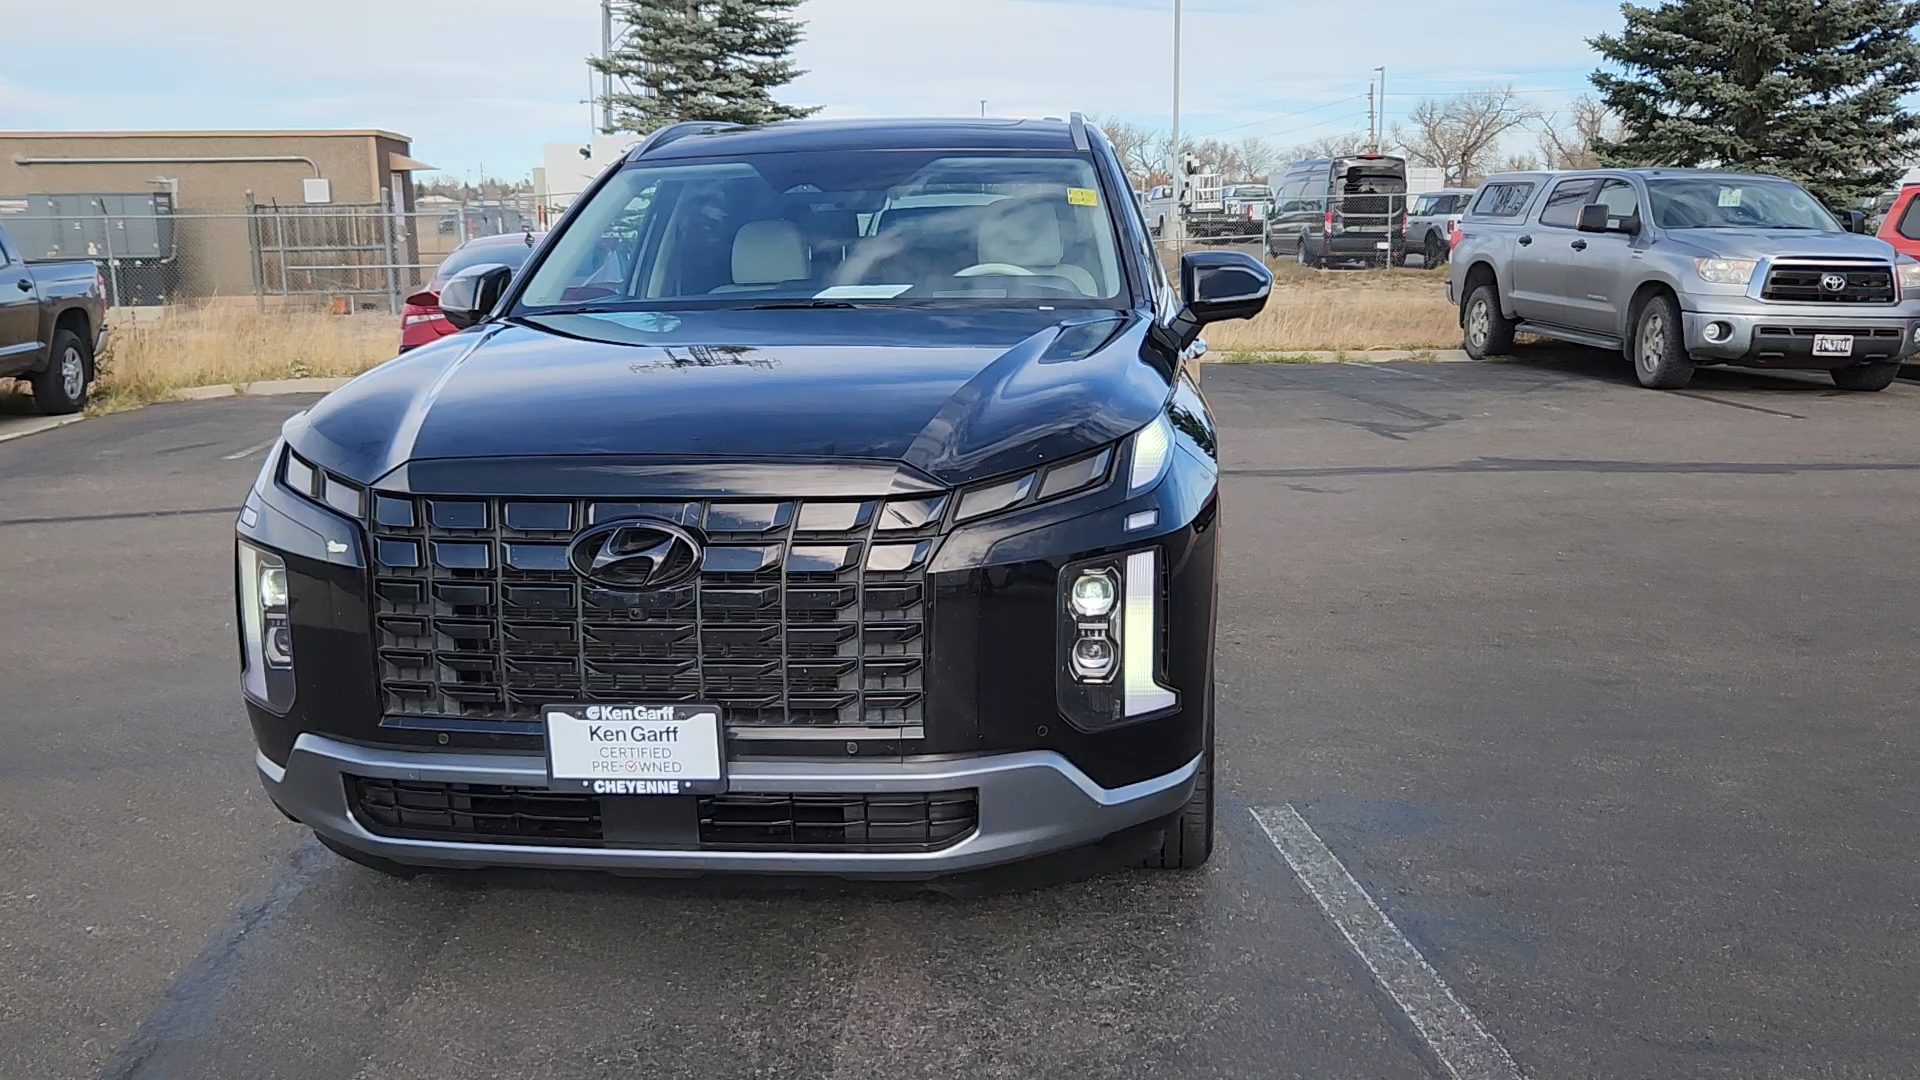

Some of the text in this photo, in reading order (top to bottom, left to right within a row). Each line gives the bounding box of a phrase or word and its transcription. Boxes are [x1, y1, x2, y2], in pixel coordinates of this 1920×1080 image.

[589, 725, 679, 742] Ken Garff
[600, 747, 672, 759] CERTIFIED
[594, 780, 680, 794] CHEYENNE
